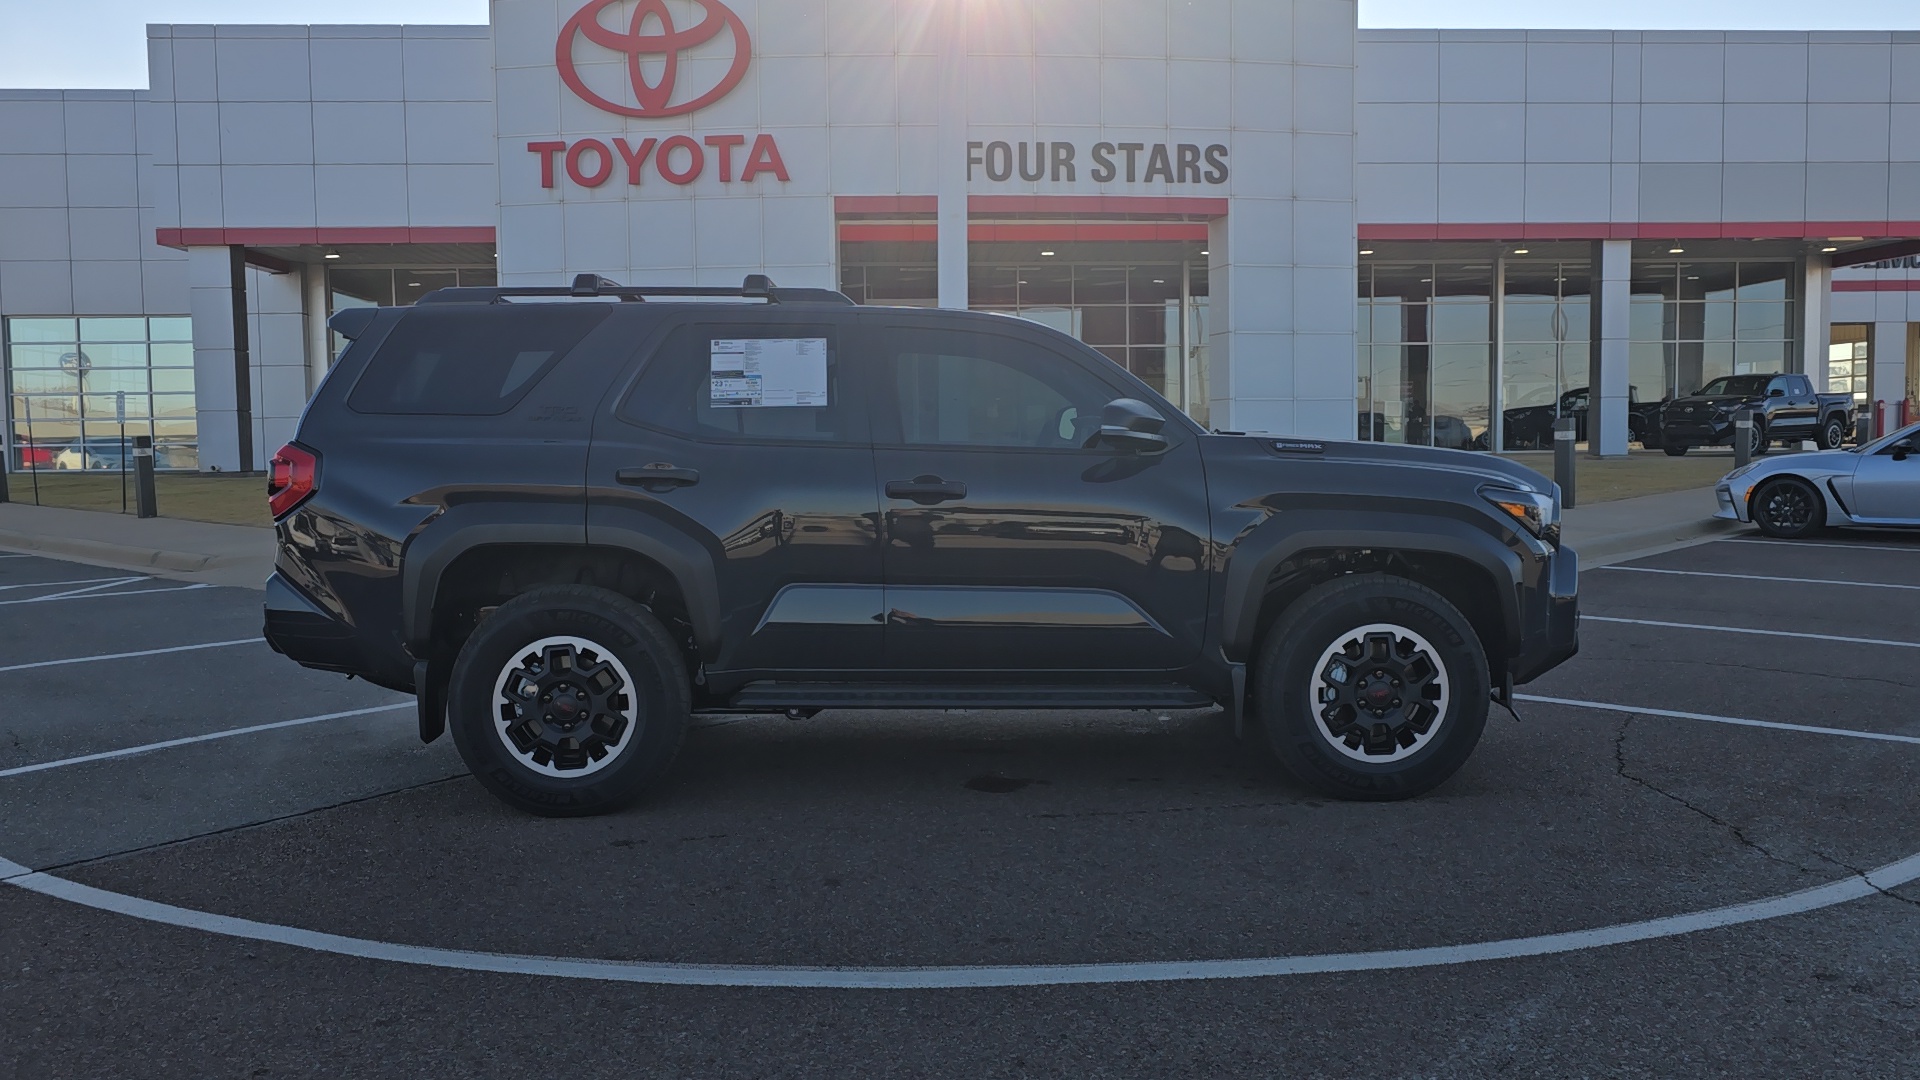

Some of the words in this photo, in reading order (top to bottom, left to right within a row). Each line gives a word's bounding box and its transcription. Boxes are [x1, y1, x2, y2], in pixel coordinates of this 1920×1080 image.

[527, 134, 790, 188] TOYOTA
[967, 141, 1076, 182] FOUR
[1091, 142, 1229, 184] STARS
